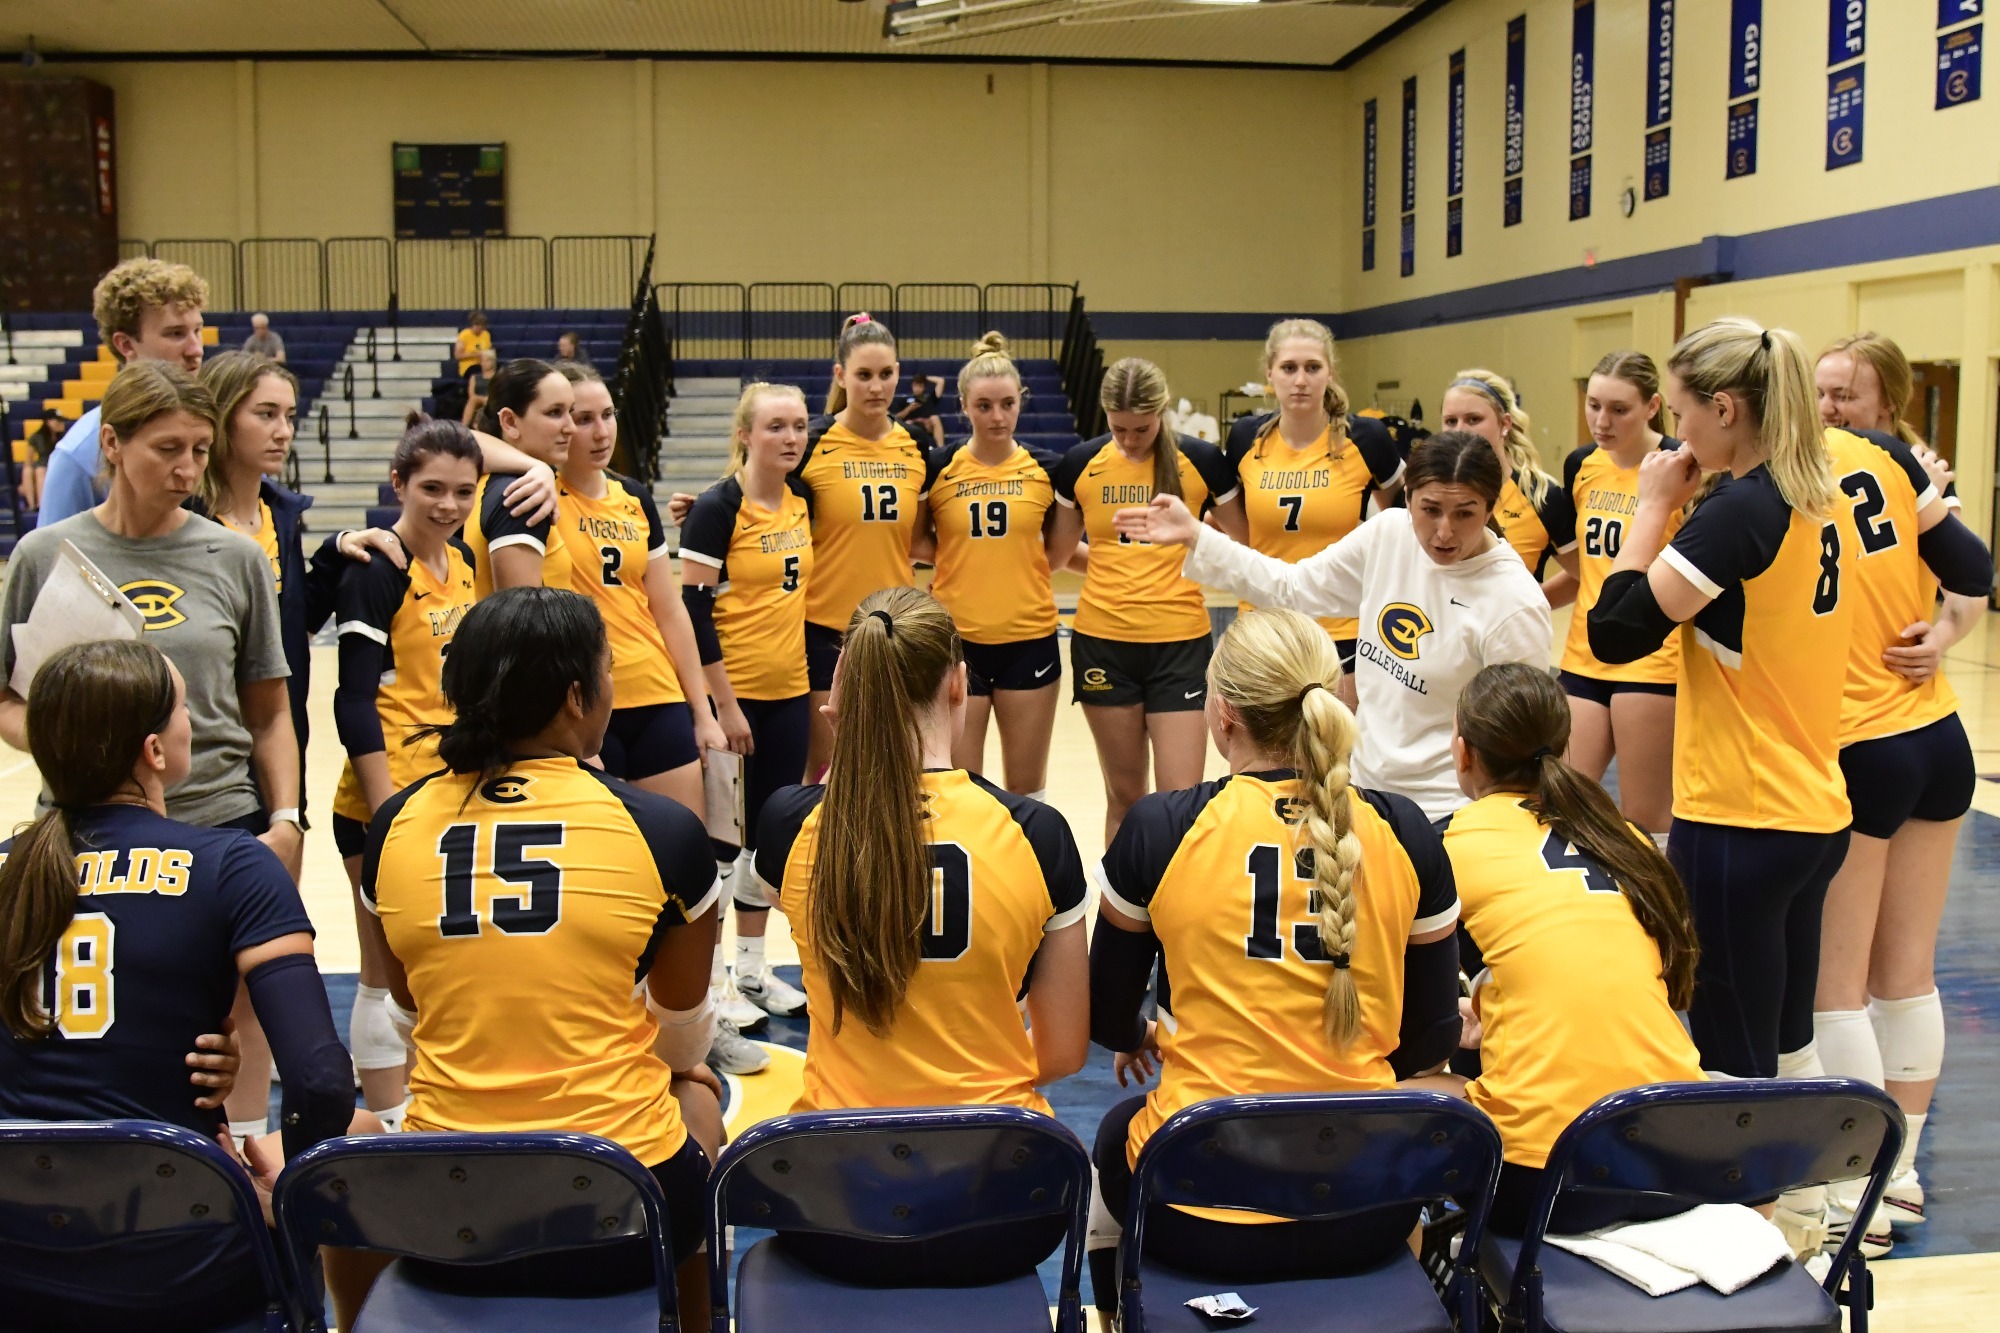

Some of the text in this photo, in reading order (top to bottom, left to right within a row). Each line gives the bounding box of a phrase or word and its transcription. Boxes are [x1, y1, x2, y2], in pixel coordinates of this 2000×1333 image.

[1845, 0, 1864, 53] OLF
[1657, 0, 1672, 120] FOOTBALL
[1743, 23, 1759, 89] GOLF
[1453, 83, 1463, 192] BASKETBALL
[843, 461, 907, 480] BLUGOLDS
[1259, 469, 1330, 490] BLUGOLDS
[861, 484, 899, 522] 12
[1102, 485, 1151, 504] BLUGOL
[1277, 495, 1304, 532] 7
[968, 500, 1008, 538] 19
[1585, 516, 1623, 559] 20
[600, 545, 624, 587] 2
[782, 555, 800, 593] 5
[1811, 521, 1841, 617] 8
[435, 820, 567, 940] 15
